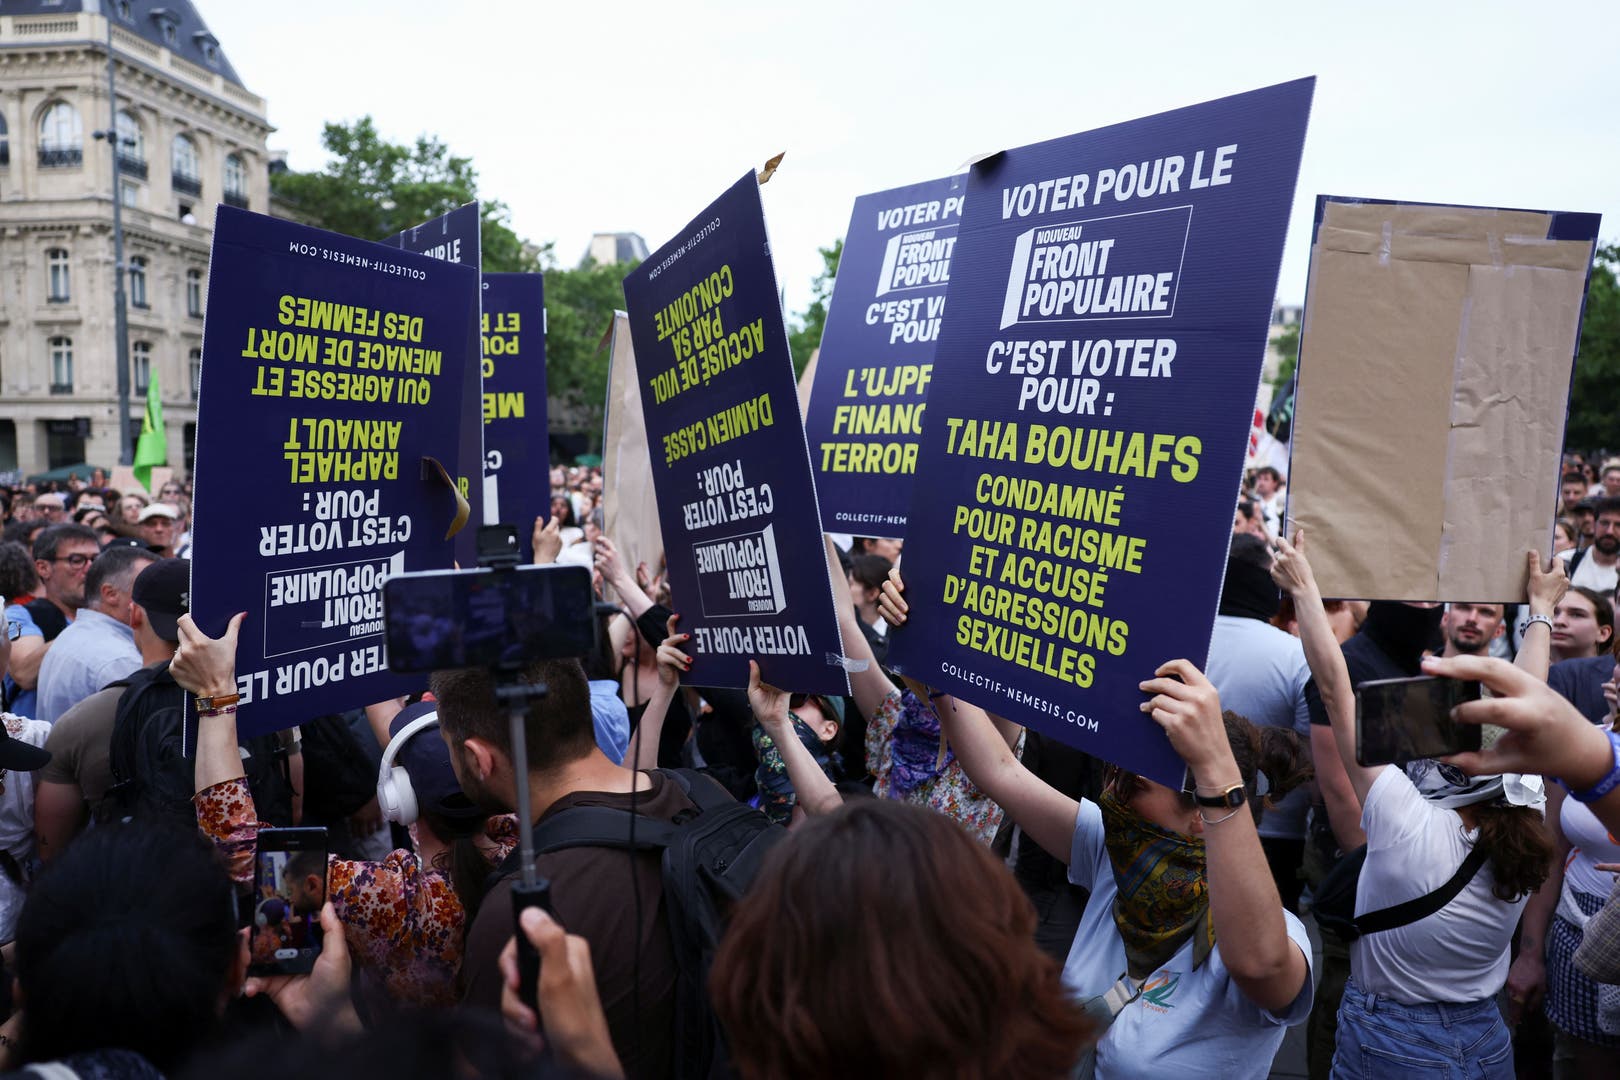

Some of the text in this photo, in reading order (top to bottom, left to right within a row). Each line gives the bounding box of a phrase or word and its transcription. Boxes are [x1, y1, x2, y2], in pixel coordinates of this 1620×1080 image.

[1002, 173, 1090, 220] VOTER
[1093, 155, 1185, 205] POUR
[1189, 143, 1238, 189] LE
[878, 201, 940, 231] VOTER
[1036, 225, 1083, 245] NOUVEAU
[447, 238, 461, 264] LE
[648, 217, 721, 281] COLLECTIF-NEMESIS.COM
[898, 237, 957, 265] FRONT
[902, 230, 935, 245] NOUVEAU
[289, 241, 426, 280] COLLECTIF-NEMESIS.COM
[892, 260, 950, 288] POPUL
[1029, 239, 1115, 281] FRONT
[654, 264, 734, 342] CONJOINTE
[865, 298, 924, 325] C'EST
[1022, 272, 1173, 317] POPULAIRE
[279, 295, 423, 343] DES FEMMES
[494, 313, 520, 332] ET
[671, 306, 723, 363] PAR SA
[242, 328, 441, 376] MENACE DE MORT
[650, 318, 764, 405] ACCUSÉ DE VIOL
[985, 339, 1177, 378] C'EST VOTER
[251, 366, 431, 405] QUI AGRESSE ET
[1018, 376, 1100, 416] POUR
[284, 418, 402, 450] ARNAULT
[662, 393, 774, 468] DAMIEN CASSÉ
[832, 403, 926, 435] FINANC
[284, 452, 399, 483] RAPHAEL
[820, 442, 919, 474] TERROR
[946, 417, 1202, 483] TAHA BOUHAFS
[703, 459, 744, 497] POUR
[315, 489, 379, 520] POUR
[683, 483, 774, 530] C'EST VOTER
[836, 512, 907, 525] COLLECTIF-NEM
[975, 473, 1125, 527] CONDAMNÉ
[259, 515, 412, 556] C'EST VOTER
[695, 537, 766, 573] POPULAIRE
[952, 505, 1147, 574] POUR RACISME
[270, 563, 388, 607] POPULAIRE
[729, 567, 771, 599] FRONT
[968, 545, 1109, 608] ET ACCUSÉ
[748, 599, 774, 611] NOUVEAU
[943, 574, 1129, 657] D'AGRESSIONS
[694, 625, 811, 655] VOTER POUR LE
[956, 614, 1096, 689] SEXUELLES
[236, 644, 389, 706] TER POUR LE
[941, 662, 1099, 733] COLLECTIF-NEMESIS.COM
